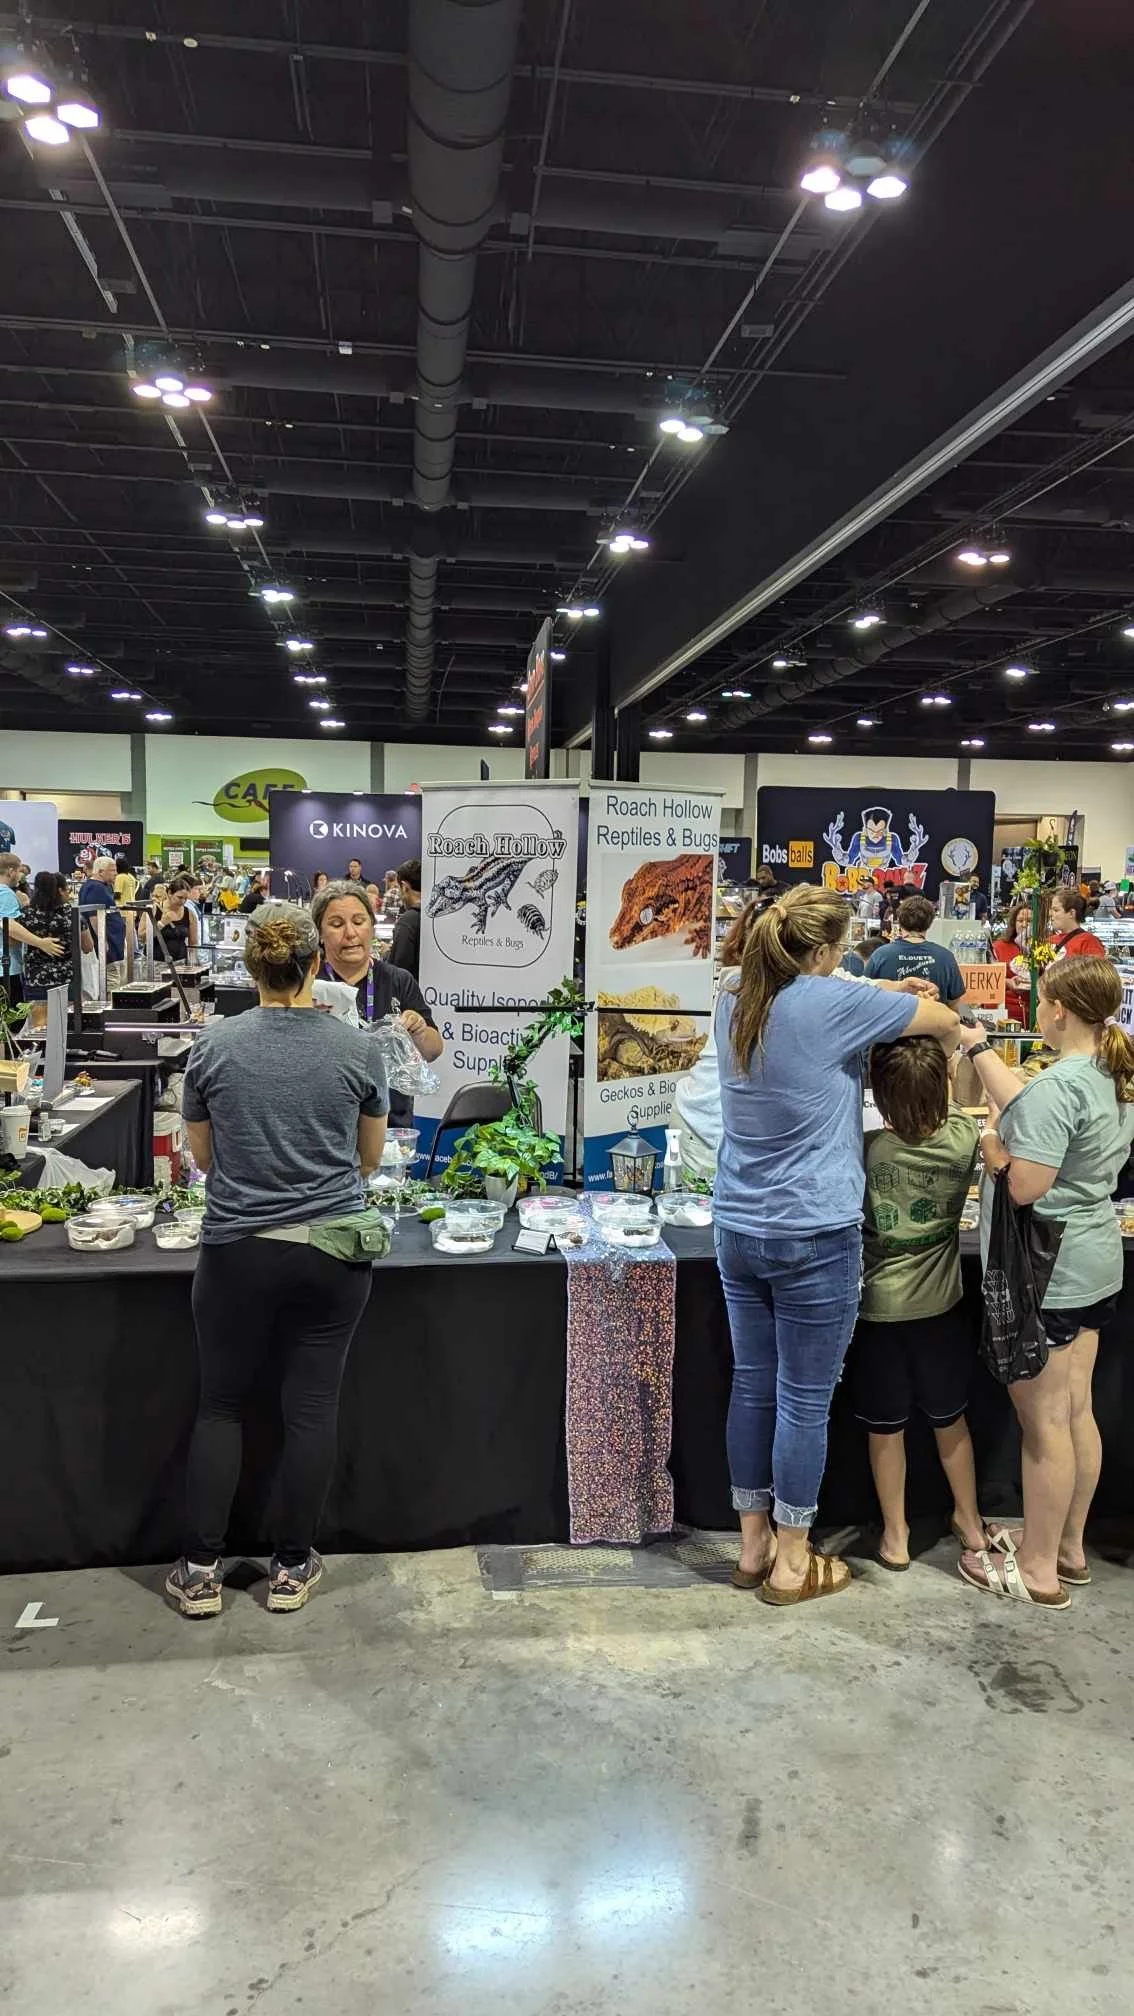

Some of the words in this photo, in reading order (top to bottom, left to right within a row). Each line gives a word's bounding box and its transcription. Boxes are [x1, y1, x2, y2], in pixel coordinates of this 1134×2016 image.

[606, 795, 657, 817] Roach
[663, 798, 713, 819] Hollow
[332, 823, 408, 839] KINOVA
[597, 825, 661, 850] Reptiles
[666, 828, 677, 847] &
[682, 828, 718, 852] Bugs
[428, 832, 490, 858] Roach
[493, 833, 568, 859] Hollow
[762, 844, 788, 864] Bobs
[789, 843, 814, 864] balls
[461, 935, 494, 949] Reptiles
[495, 938, 503, 946] &
[505, 937, 524, 950] Bugs
[964, 972, 1002, 990] JERKY
[424, 987, 485, 1013] Quality
[492, 992, 551, 1016] Isopo
[441, 1022, 455, 1041] &
[452, 1050, 503, 1076] Suppl
[600, 1085, 644, 1103] Geckos
[647, 1081, 656, 1097] &
[630, 1101, 672, 1121] Supplie
